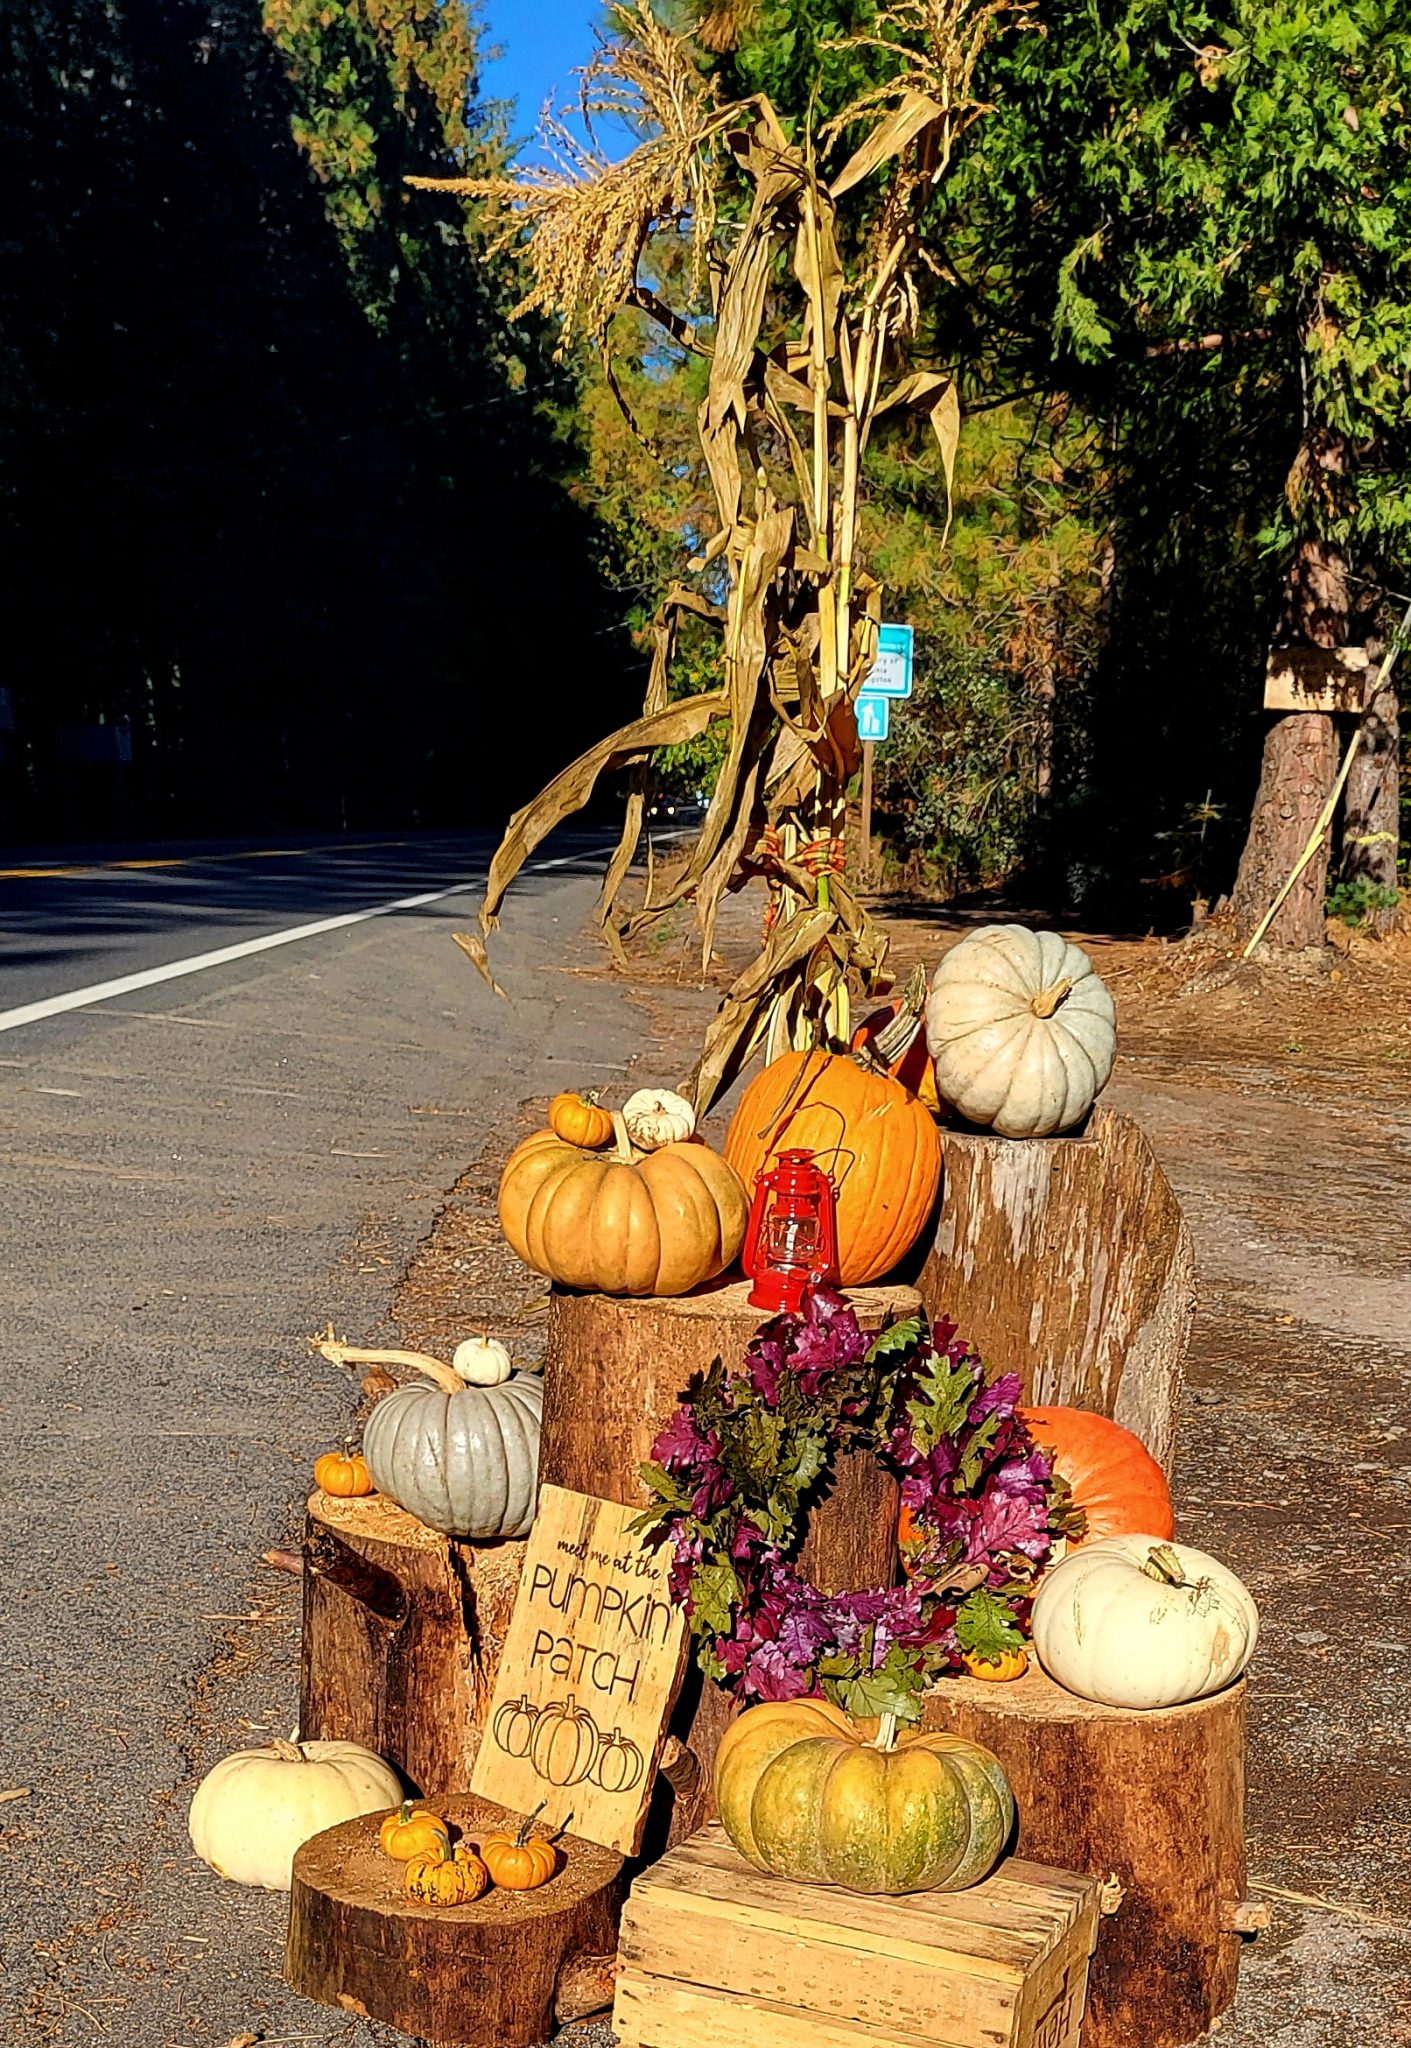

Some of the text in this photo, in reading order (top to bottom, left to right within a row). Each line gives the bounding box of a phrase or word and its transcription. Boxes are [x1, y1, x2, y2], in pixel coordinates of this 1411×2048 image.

[557, 1538, 661, 1580] meet me at the
